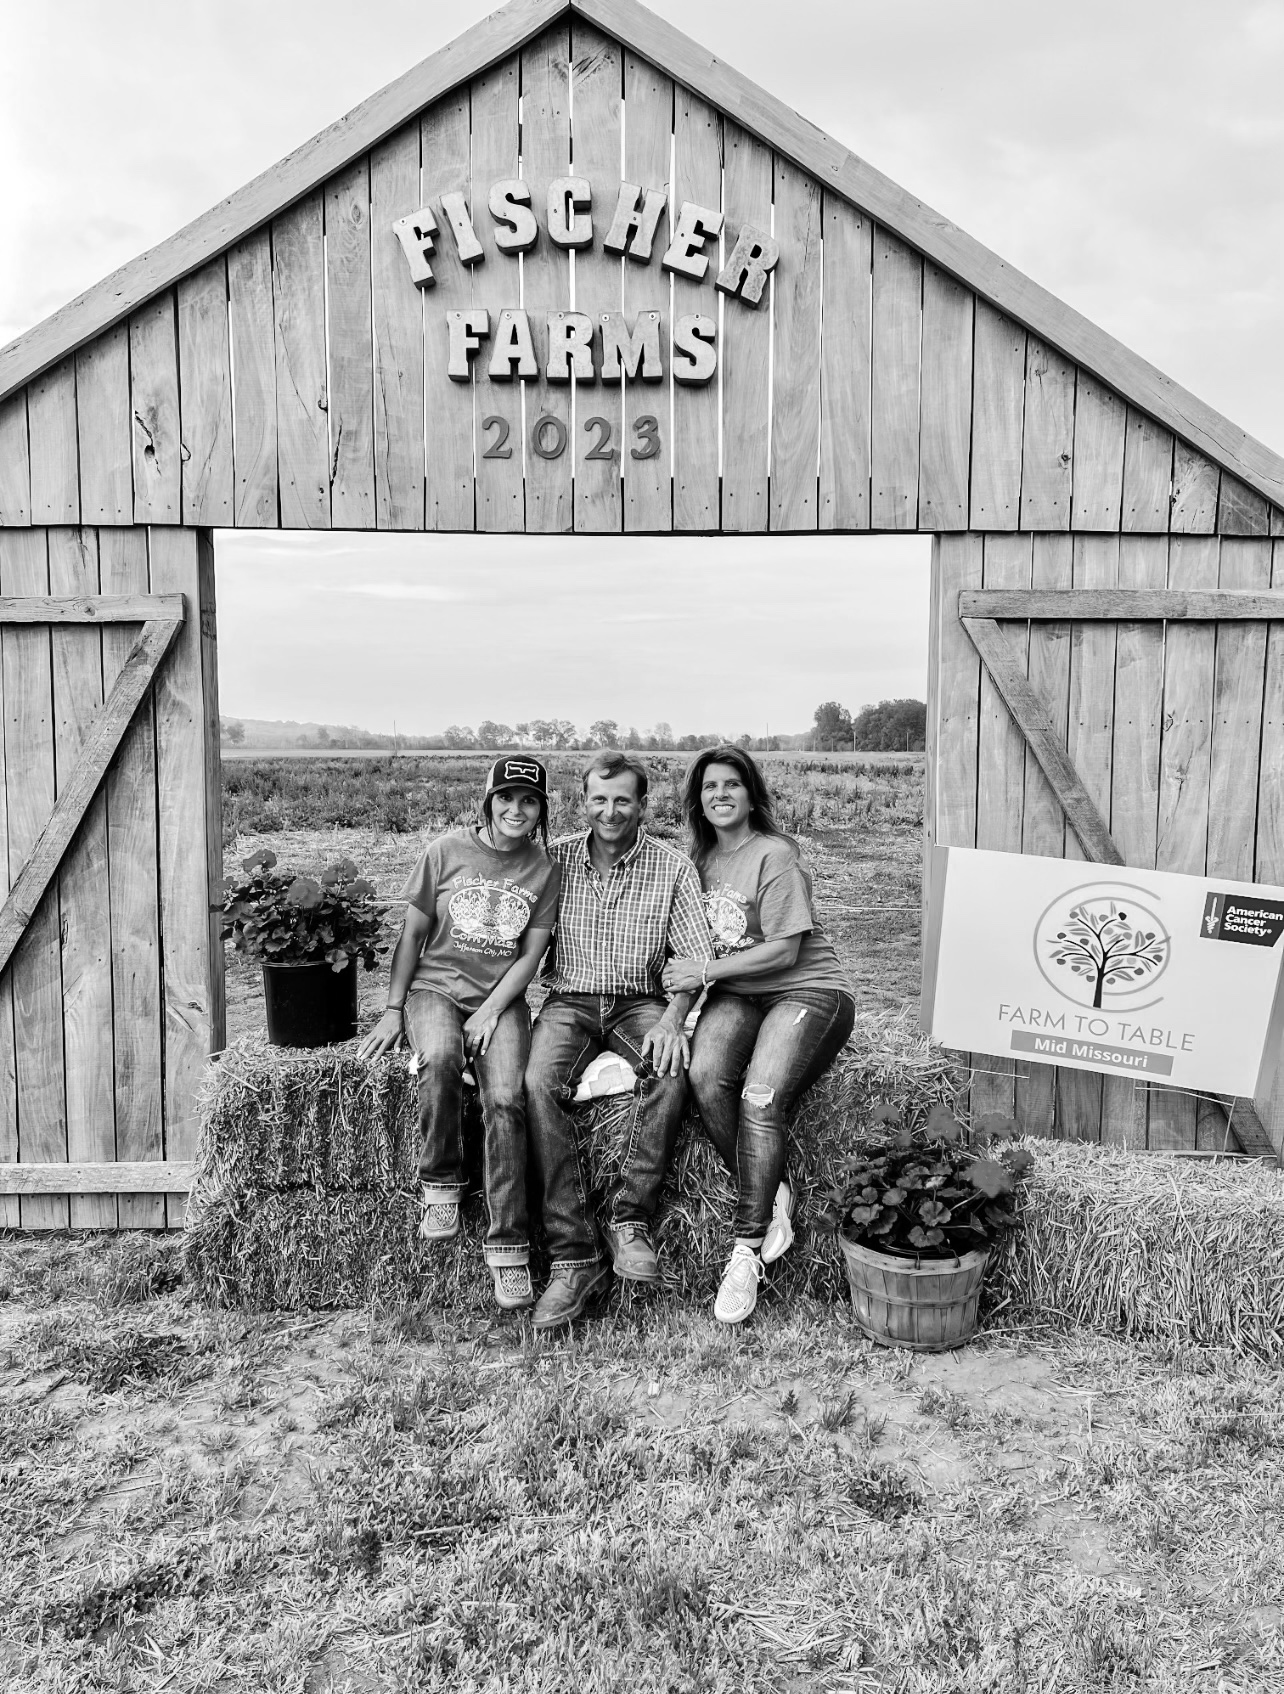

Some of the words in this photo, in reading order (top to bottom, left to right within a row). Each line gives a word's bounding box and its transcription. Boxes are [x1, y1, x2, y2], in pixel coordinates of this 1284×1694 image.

[391, 176, 781, 310] FISCHER
[446, 308, 718, 386] FARMS
[481, 415, 661, 460] 2023
[503, 876, 539, 904] Farms
[1225, 913, 1267, 927] Cancer
[1226, 905, 1284, 921] American
[449, 925, 481, 944] Corn
[453, 940, 483, 954] Jefferson
[497, 949, 513, 957] MO
[997, 1002, 1066, 1031] FARM
[1074, 1014, 1110, 1038] TO
[1117, 1022, 1196, 1052] TABLE
[1034, 1037, 1067, 1056] Mid
[1071, 1044, 1149, 1068] Missouri
